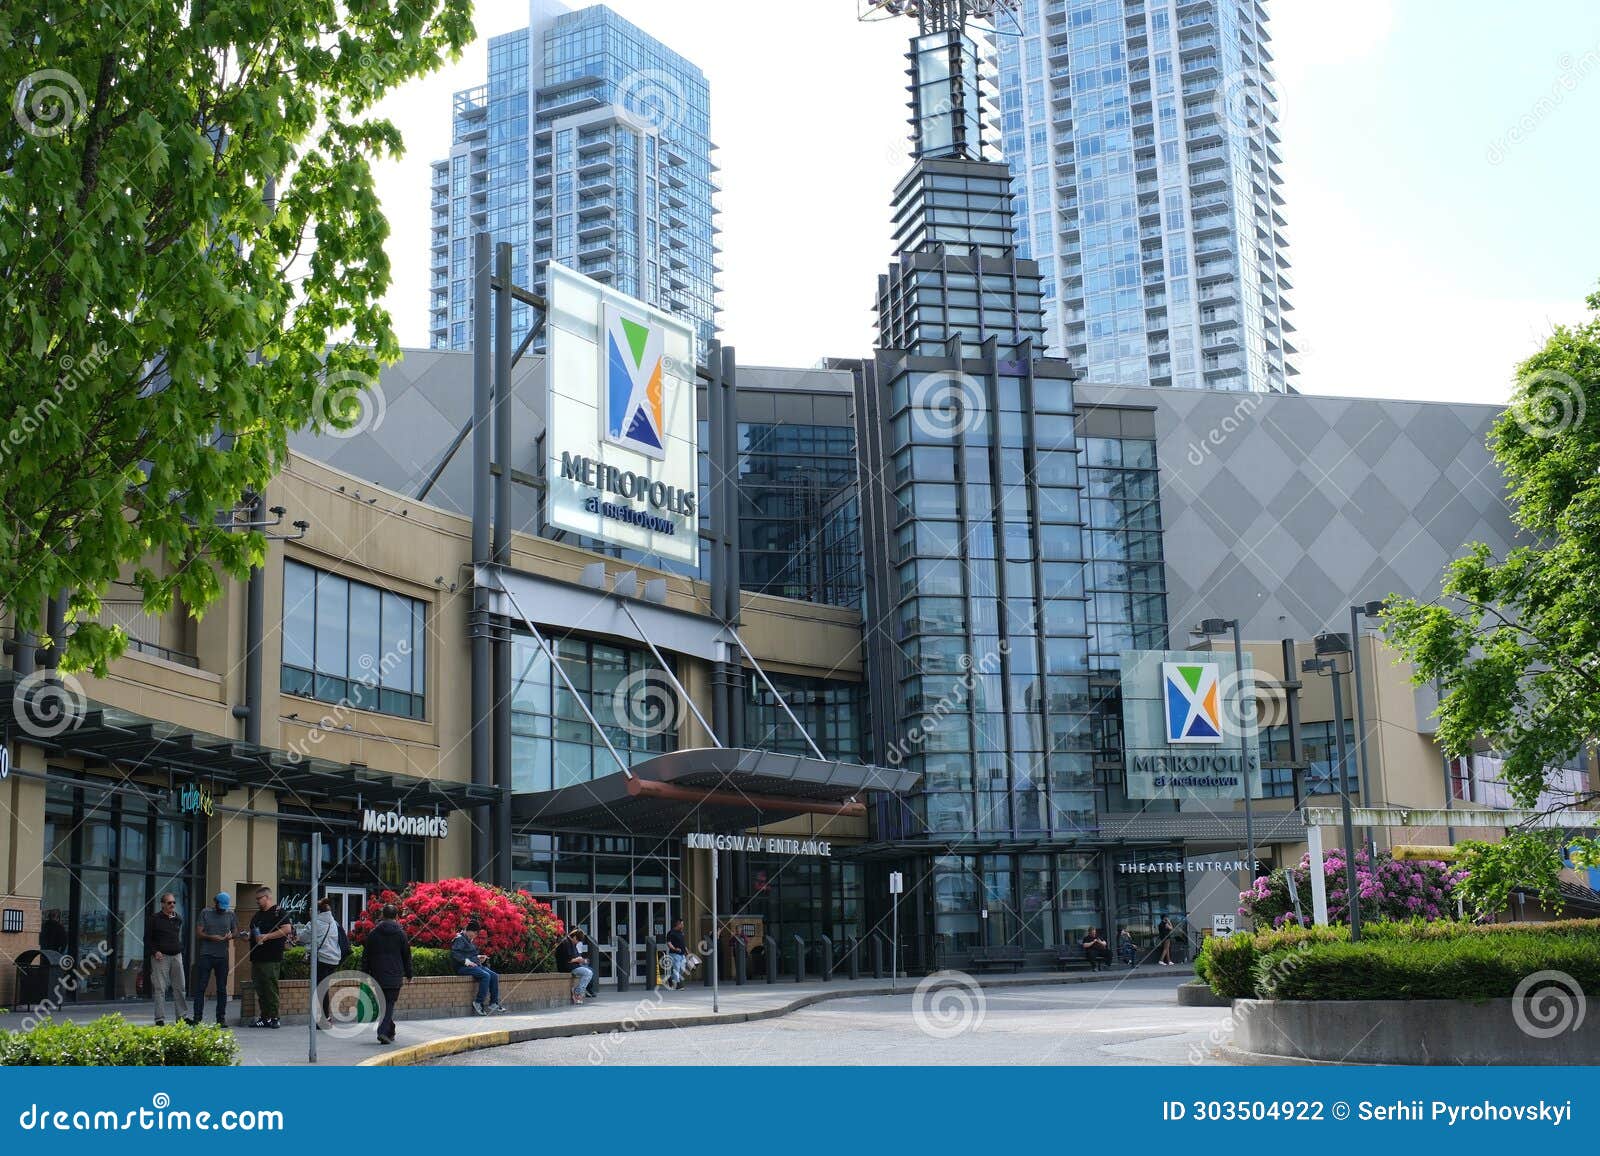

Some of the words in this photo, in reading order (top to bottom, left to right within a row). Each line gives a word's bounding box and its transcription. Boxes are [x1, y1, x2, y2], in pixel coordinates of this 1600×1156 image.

[560, 451, 696, 517] METROPOLIS
[585, 496, 600, 513] at
[603, 502, 674, 535] metrotown
[1170, 776, 1238, 786] metrotown
[363, 809, 448, 838] McDonald's
[688, 832, 763, 852] KINGSWAY
[766, 838, 832, 856] ENTRANCE
[1119, 862, 1182, 874] THEATRE
